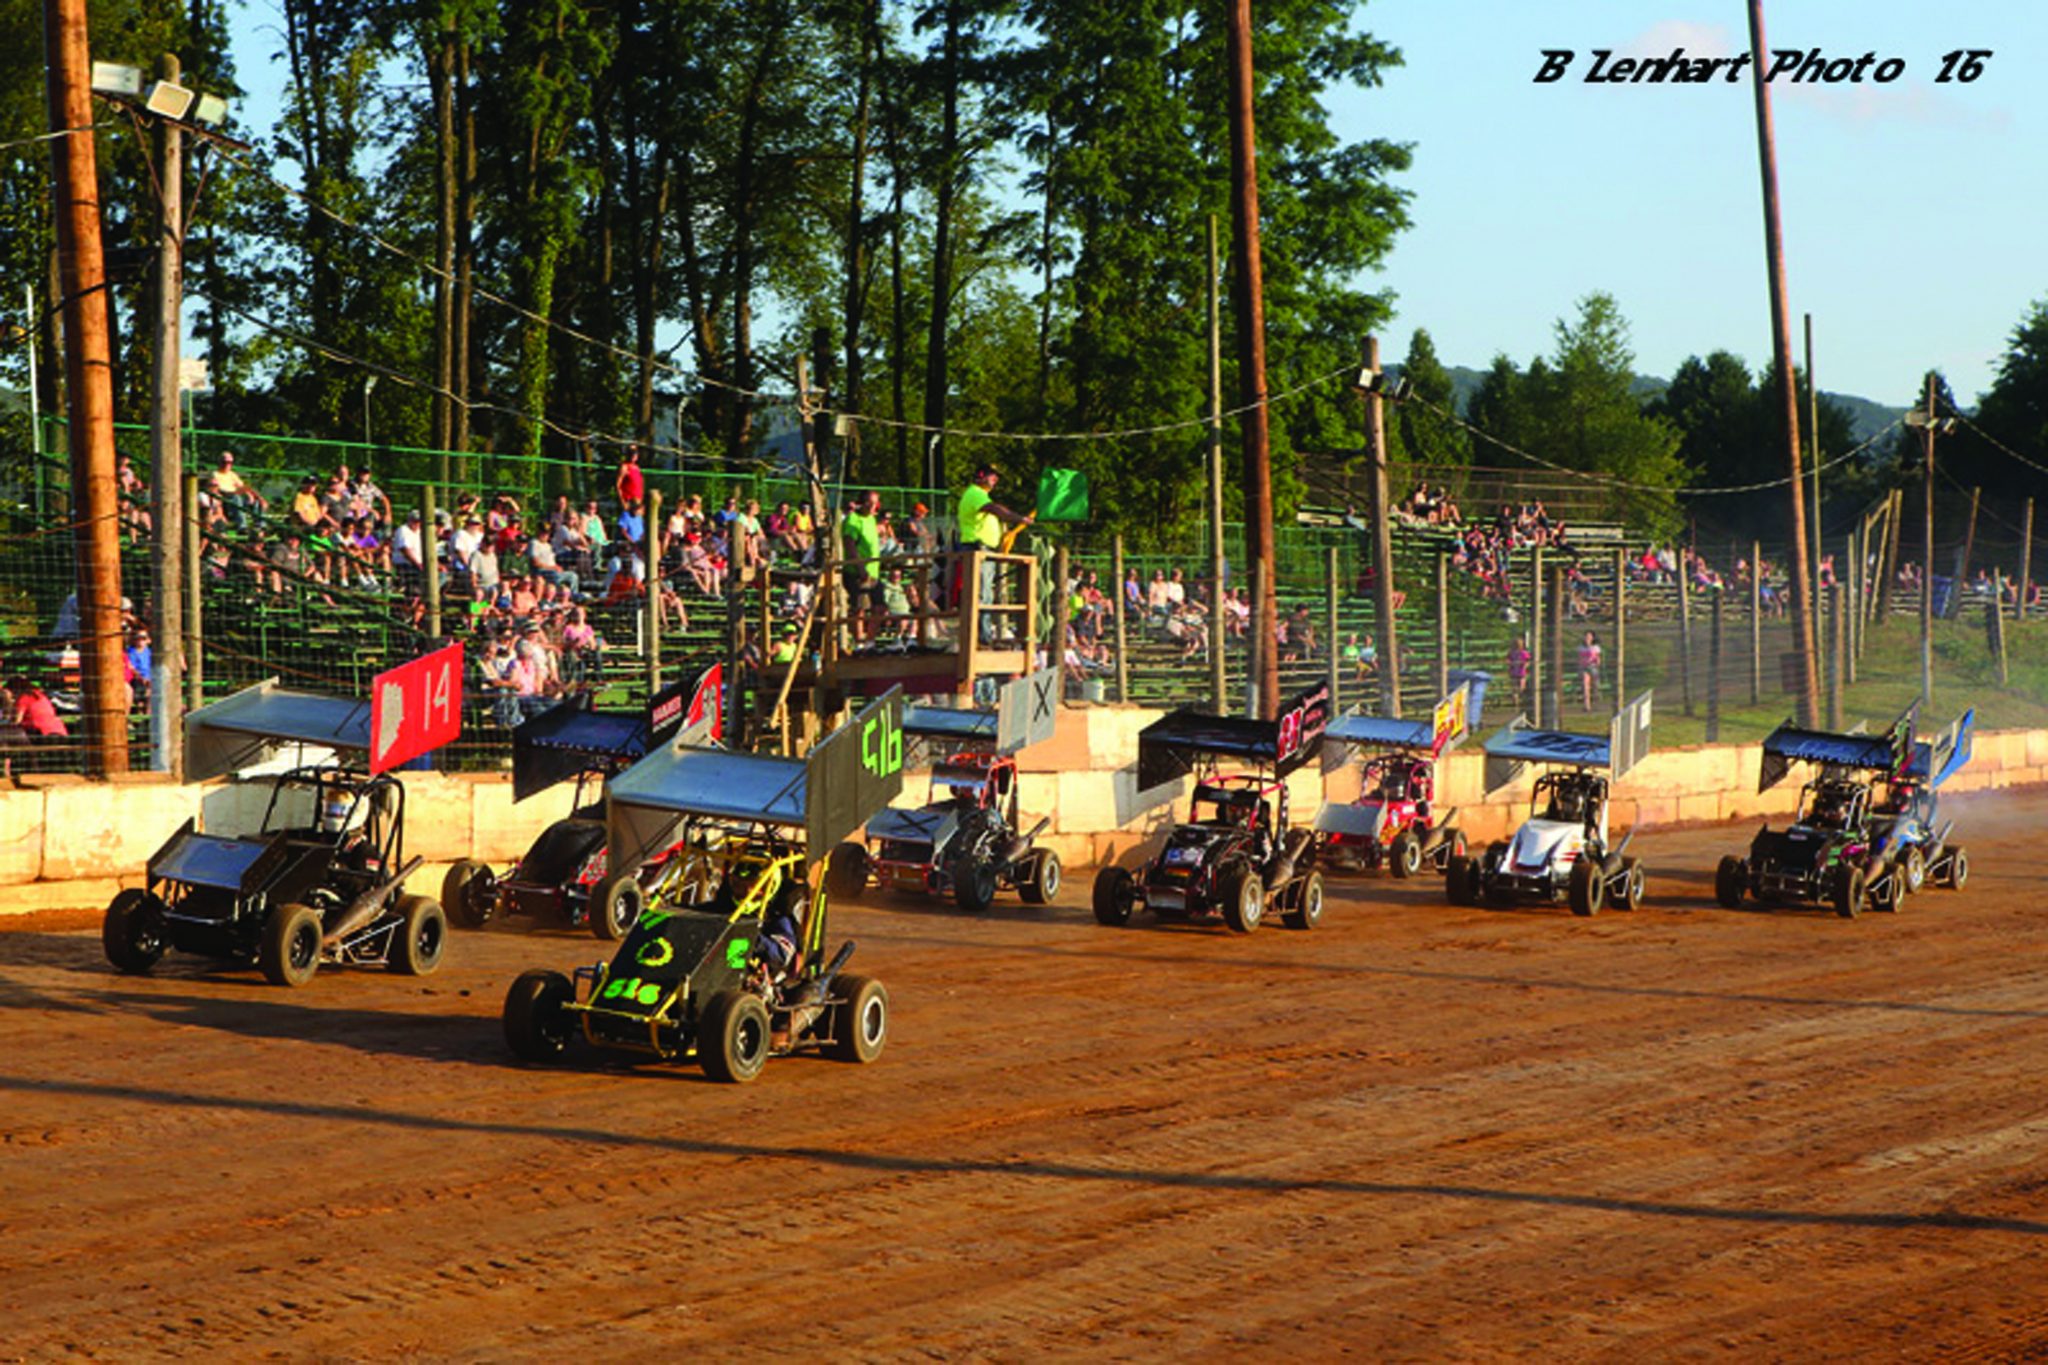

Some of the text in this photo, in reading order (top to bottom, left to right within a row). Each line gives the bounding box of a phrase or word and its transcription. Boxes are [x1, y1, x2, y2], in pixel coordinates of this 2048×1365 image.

[424, 661, 450, 731] 14
[1033, 675, 1052, 723] X
[603, 977, 662, 1005] 516
